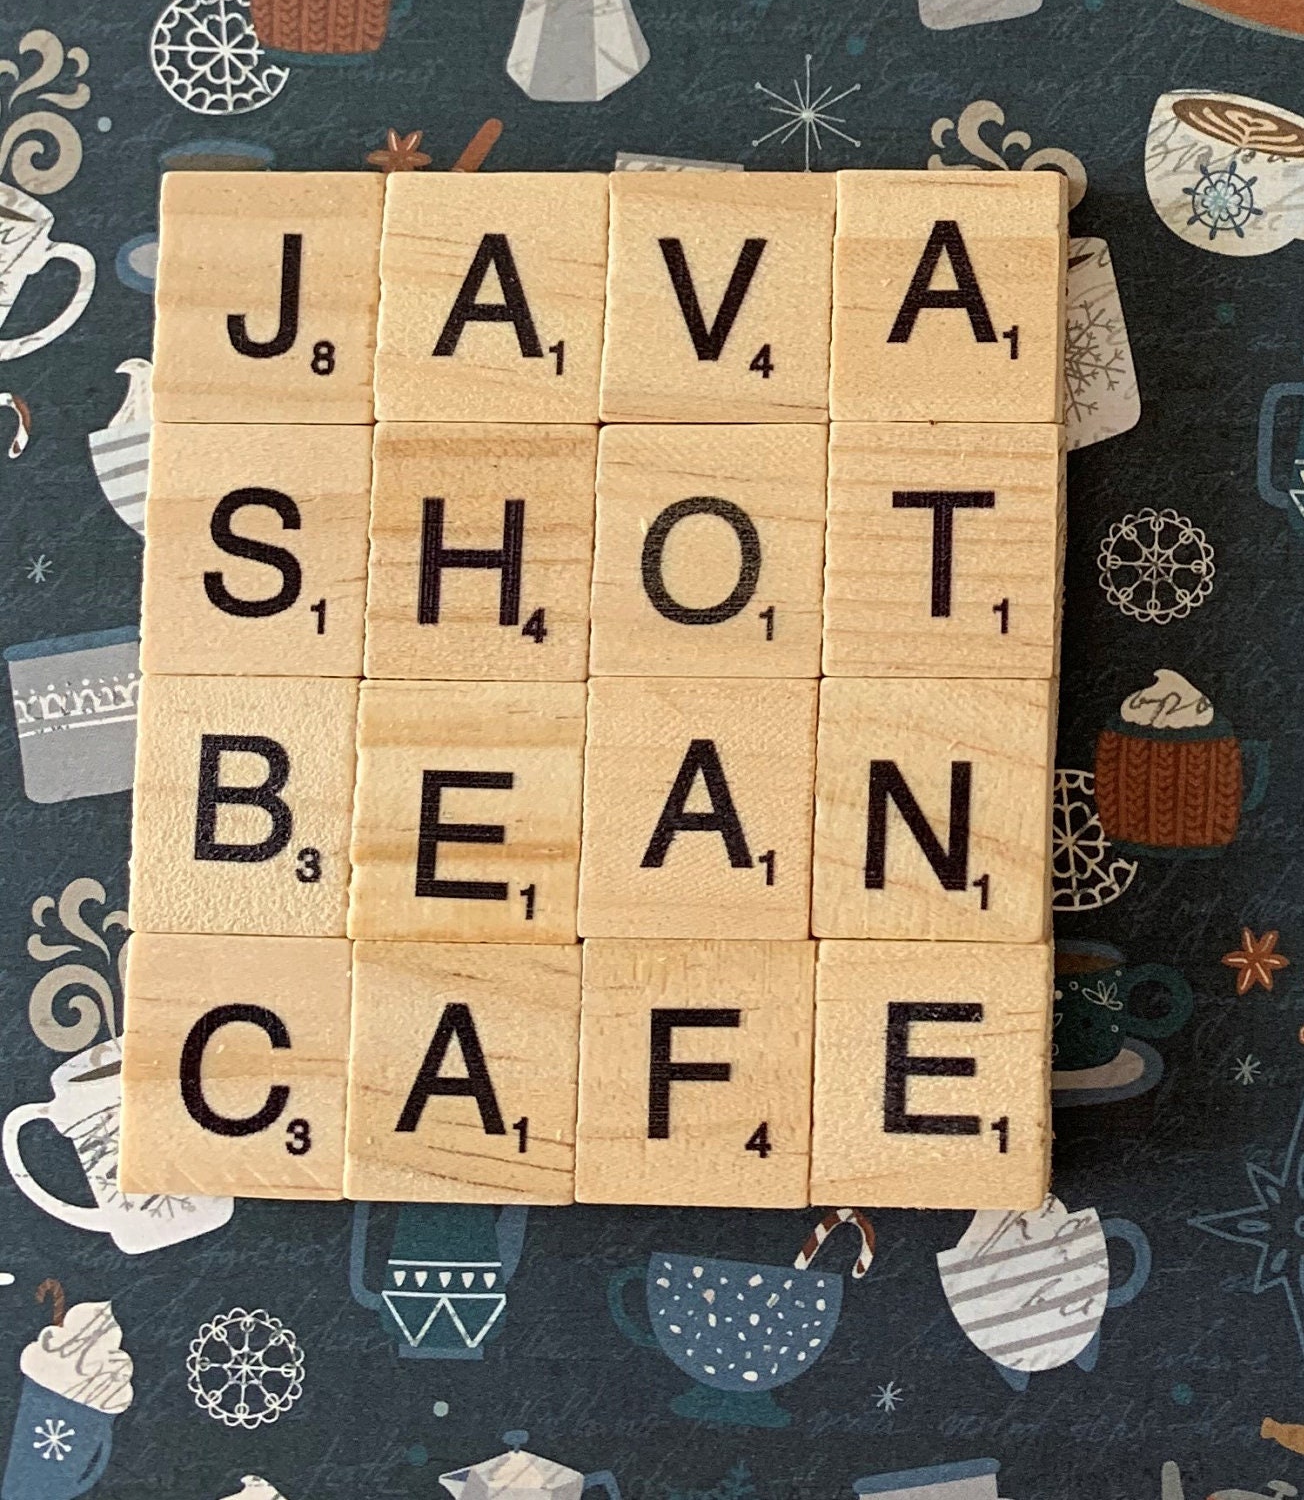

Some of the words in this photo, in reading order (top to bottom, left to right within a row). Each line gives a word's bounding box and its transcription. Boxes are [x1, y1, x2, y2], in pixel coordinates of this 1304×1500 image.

[309, 339, 337, 377] 8
[547, 339, 566, 377] 1
[747, 342, 776, 380] 4
[1001, 324, 1020, 361] 1
[309, 597, 327, 636] 1
[520, 606, 549, 645] 4
[757, 604, 776, 643] 1
[991, 597, 1010, 636] 1
[294, 846, 323, 885] 3
[518, 882, 537, 922] 1
[757, 848, 777, 887] 1
[971, 872, 991, 912] 1
[284, 1117, 313, 1157] 3
[511, 1115, 530, 1155] 1
[743, 1120, 773, 1160] 4
[990, 1114, 1010, 1155] 1
